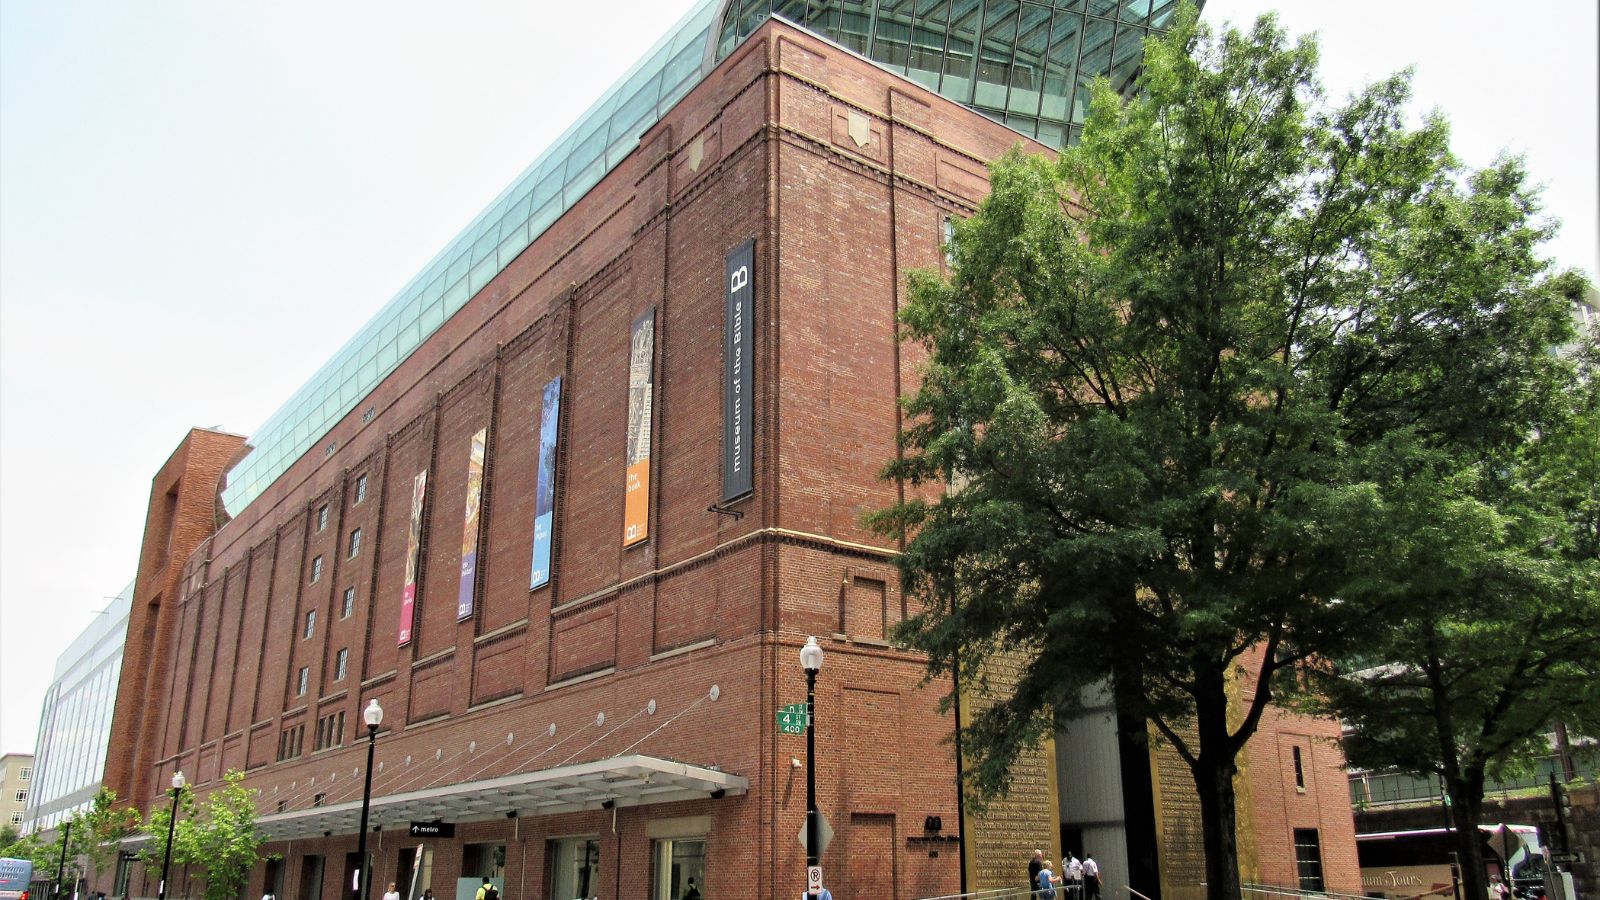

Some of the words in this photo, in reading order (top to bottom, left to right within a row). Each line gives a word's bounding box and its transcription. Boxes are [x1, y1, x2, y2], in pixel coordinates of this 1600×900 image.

[731, 265, 748, 294] B
[733, 301, 742, 344] Bible
[734, 378, 741, 393] of
[783, 714, 791, 724] 4
[1385, 871, 1422, 888] Tours
